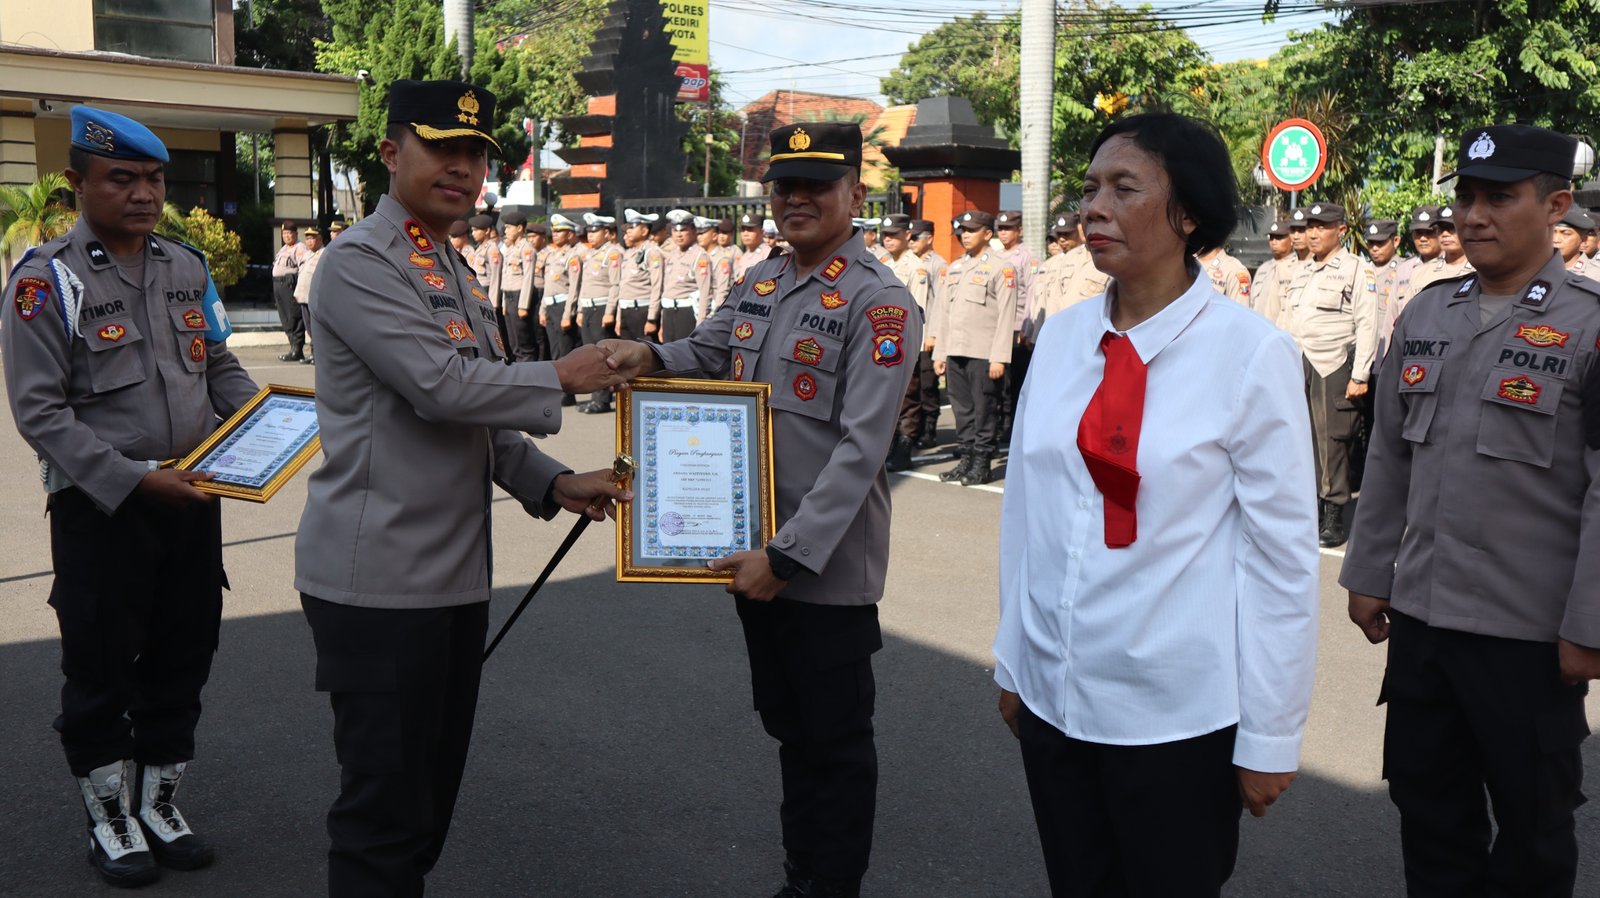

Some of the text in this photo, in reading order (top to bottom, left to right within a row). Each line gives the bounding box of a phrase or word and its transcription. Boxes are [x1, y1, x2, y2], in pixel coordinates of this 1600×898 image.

[663, 3, 704, 16] POLRES
[667, 16, 699, 28] KEDIRI
[671, 28, 696, 39] KOTA
[80, 299, 125, 322] TIMOR
[870, 307, 904, 316] POLRES
[800, 313, 844, 337] POLRI
[1499, 348, 1567, 375] POLRI
